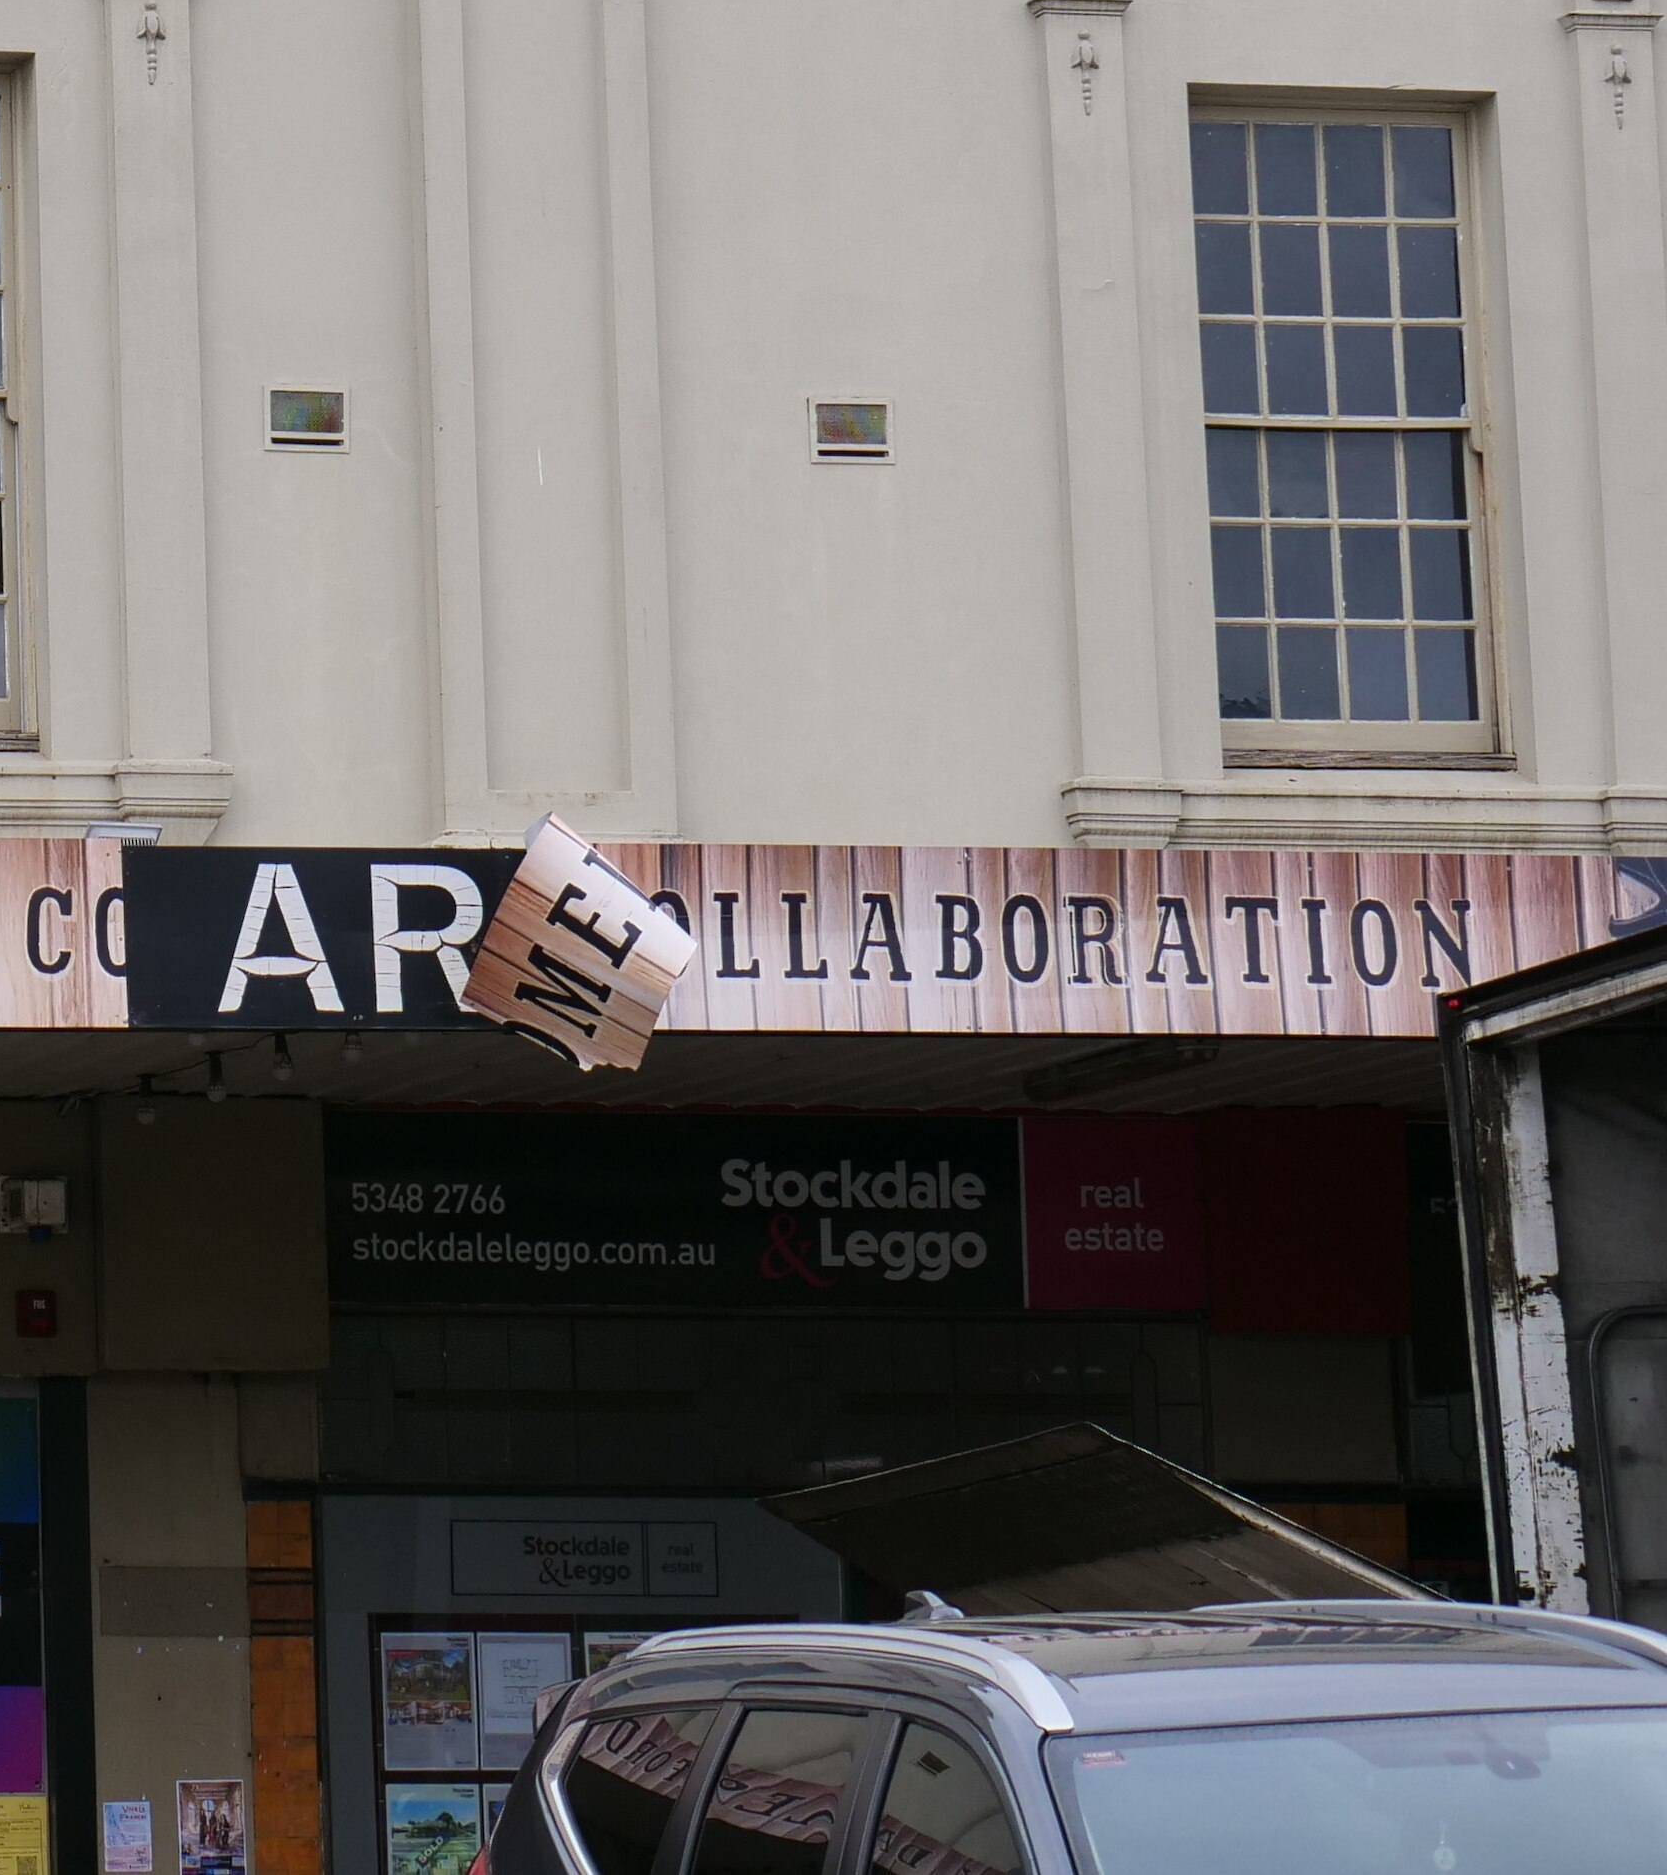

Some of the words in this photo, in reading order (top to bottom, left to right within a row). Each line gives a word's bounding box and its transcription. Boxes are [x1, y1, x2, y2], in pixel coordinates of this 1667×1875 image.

[350, 1182, 425, 1215] 5348
[432, 1184, 506, 1217] 2766
[720, 1158, 986, 1212] Stockdale
[1079, 1176, 1144, 1210] real
[351, 1230, 717, 1273] stockdaleleggo.com.au
[1063, 1221, 1165, 1254] estate
[522, 1535, 630, 1557] Stockdale
[667, 1541, 695, 1557] real
[661, 1559, 703, 1574] estate
